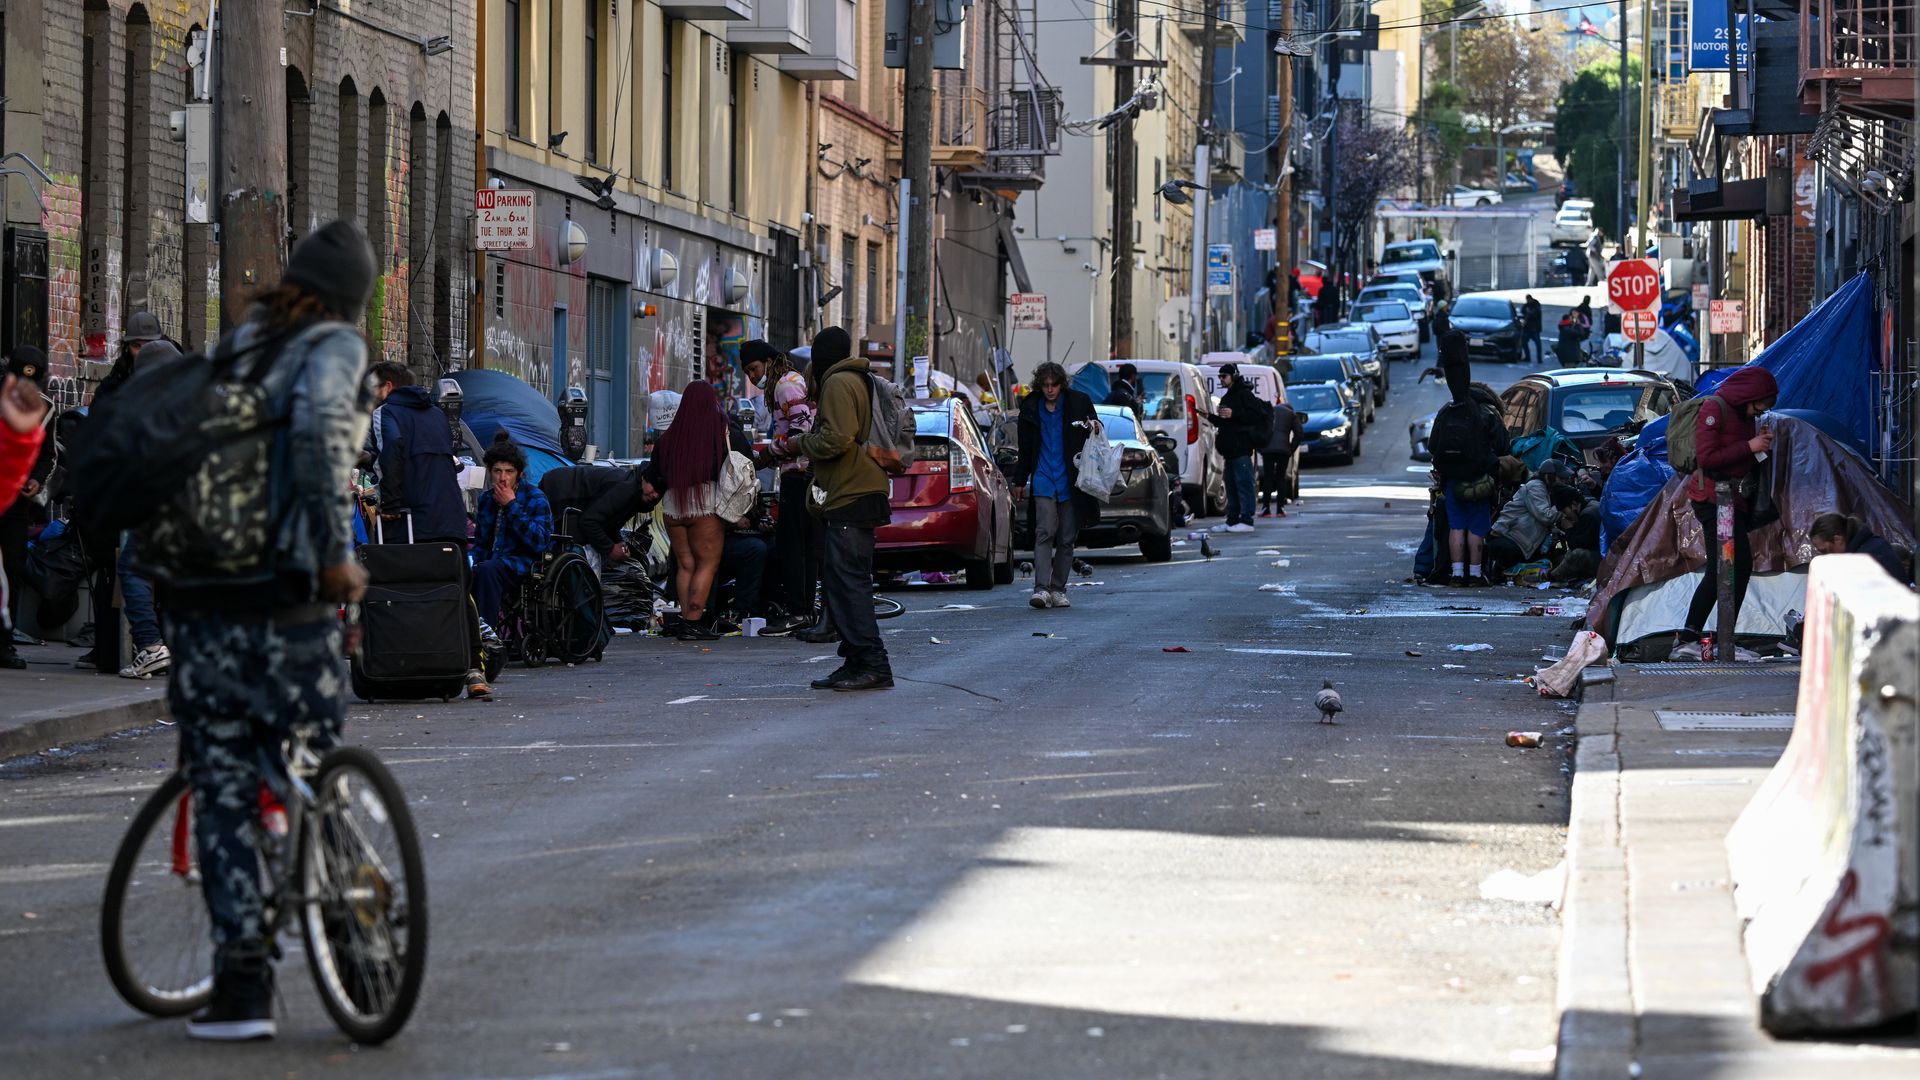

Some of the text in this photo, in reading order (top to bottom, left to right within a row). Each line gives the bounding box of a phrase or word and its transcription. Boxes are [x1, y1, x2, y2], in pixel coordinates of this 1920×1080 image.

[1693, 42, 1748, 51] MOTORYC
[478, 191, 532, 207] NO PARKING
[1611, 275, 1656, 297] STOP
[1023, 296, 1044, 304] PARKING
[1711, 302, 1723, 311] NO
